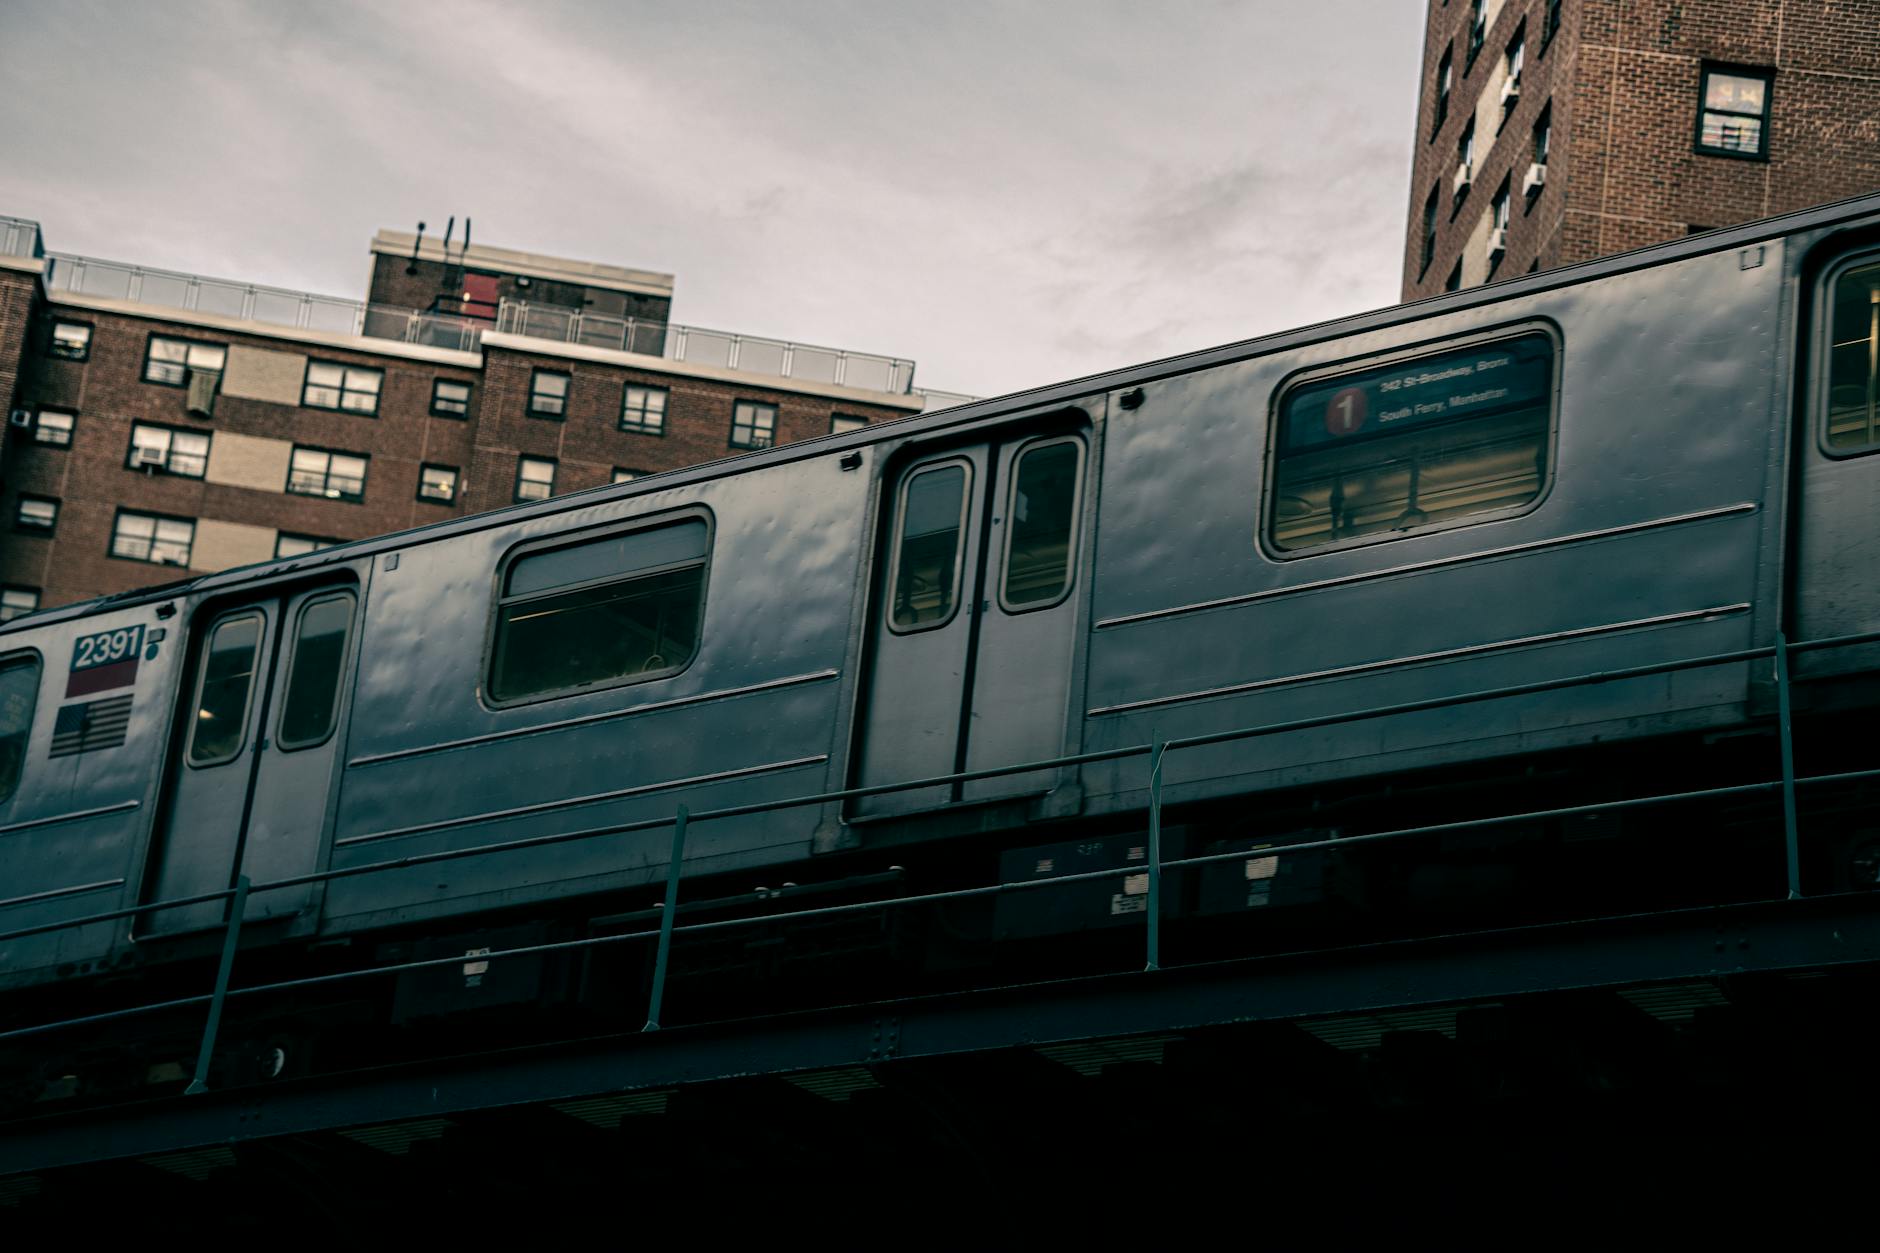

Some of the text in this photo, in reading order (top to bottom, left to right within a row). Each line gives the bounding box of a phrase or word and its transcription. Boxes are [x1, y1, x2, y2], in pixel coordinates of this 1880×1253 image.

[1476, 357, 1509, 372] Bronx
[1336, 394, 1353, 430] 1
[1378, 406, 1412, 423] South
[1449, 387, 1509, 408] Manhattan
[75, 626, 140, 668] 2391
